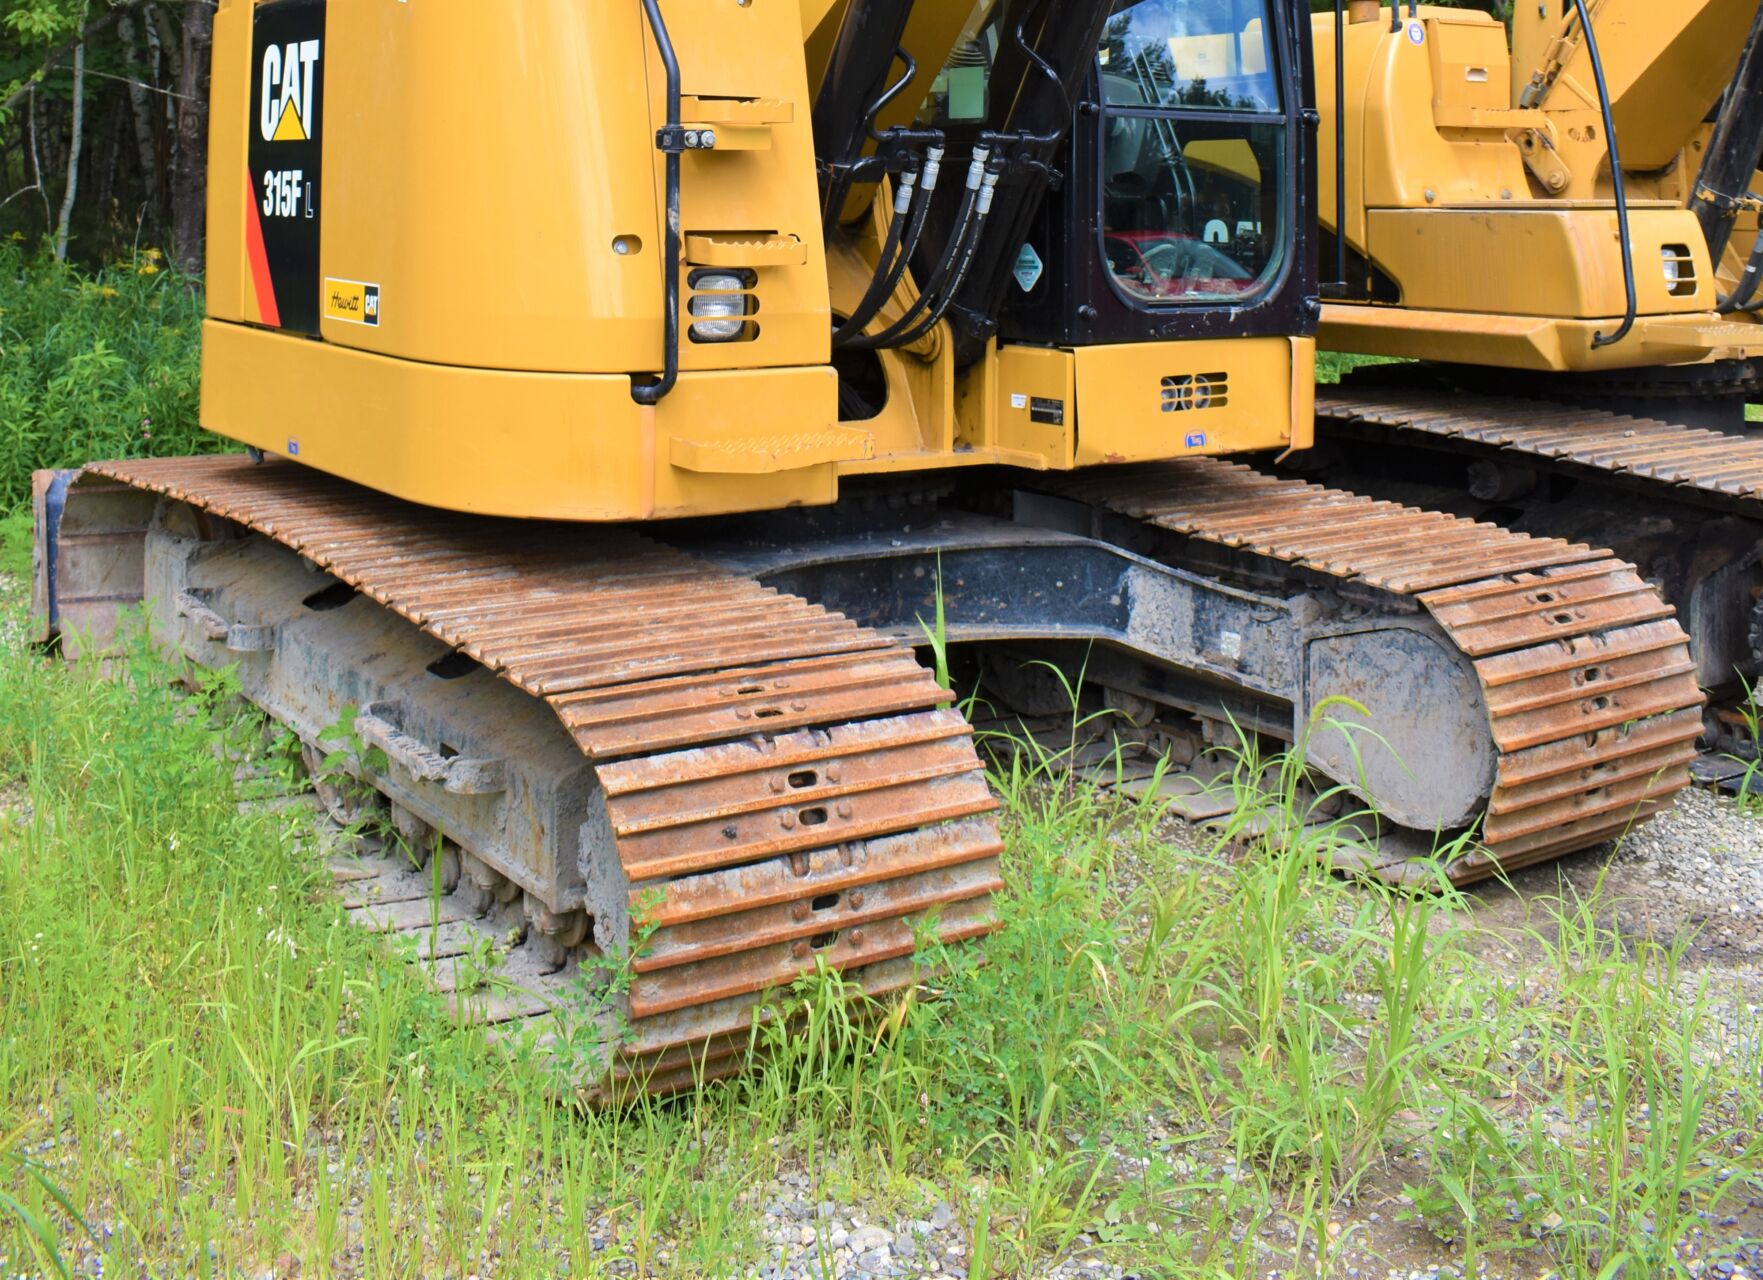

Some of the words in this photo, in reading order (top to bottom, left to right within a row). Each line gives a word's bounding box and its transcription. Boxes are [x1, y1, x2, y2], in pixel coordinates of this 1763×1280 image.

[260, 39, 320, 141] CAT
[262, 170, 303, 218] 315F
[365, 294, 378, 316] CAT
